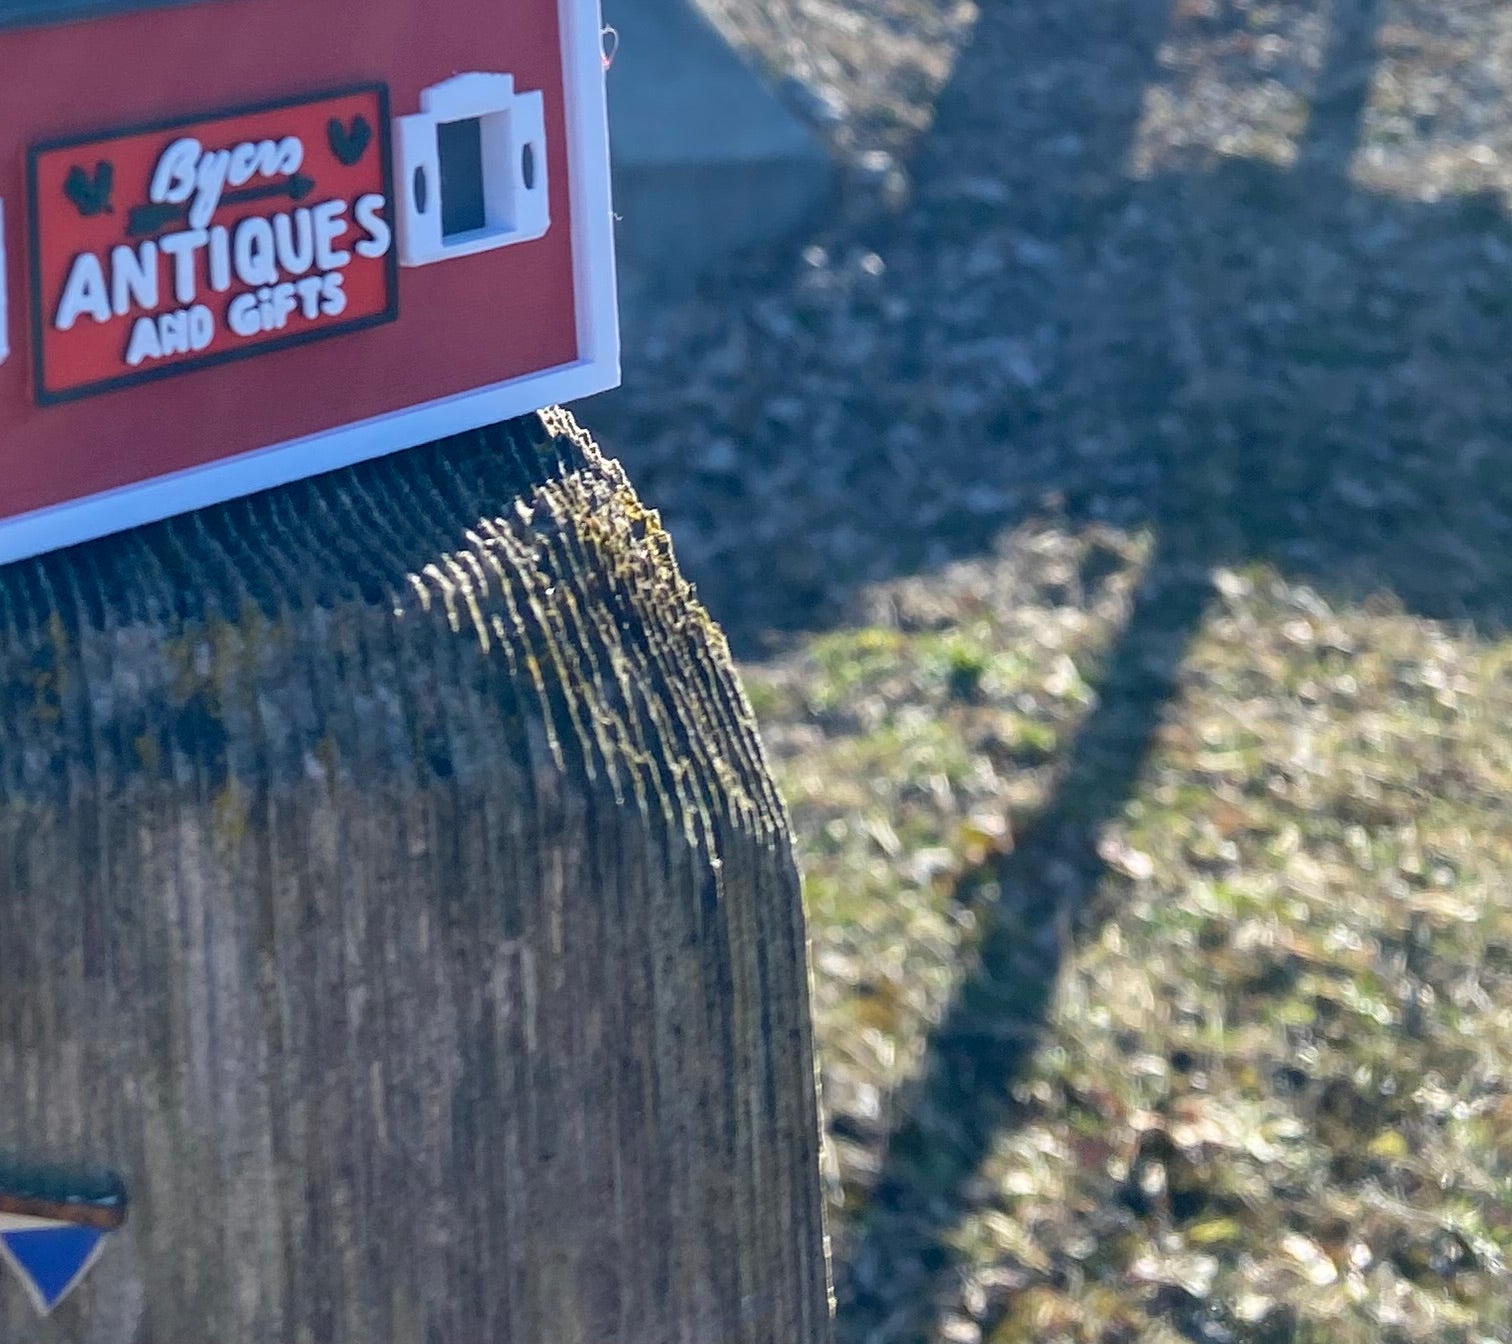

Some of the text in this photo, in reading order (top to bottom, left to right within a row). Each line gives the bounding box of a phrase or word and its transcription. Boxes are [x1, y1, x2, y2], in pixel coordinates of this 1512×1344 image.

[149, 136, 304, 229] Byers
[55, 194, 391, 330] ANTIQUES
[125, 304, 215, 367] AND
